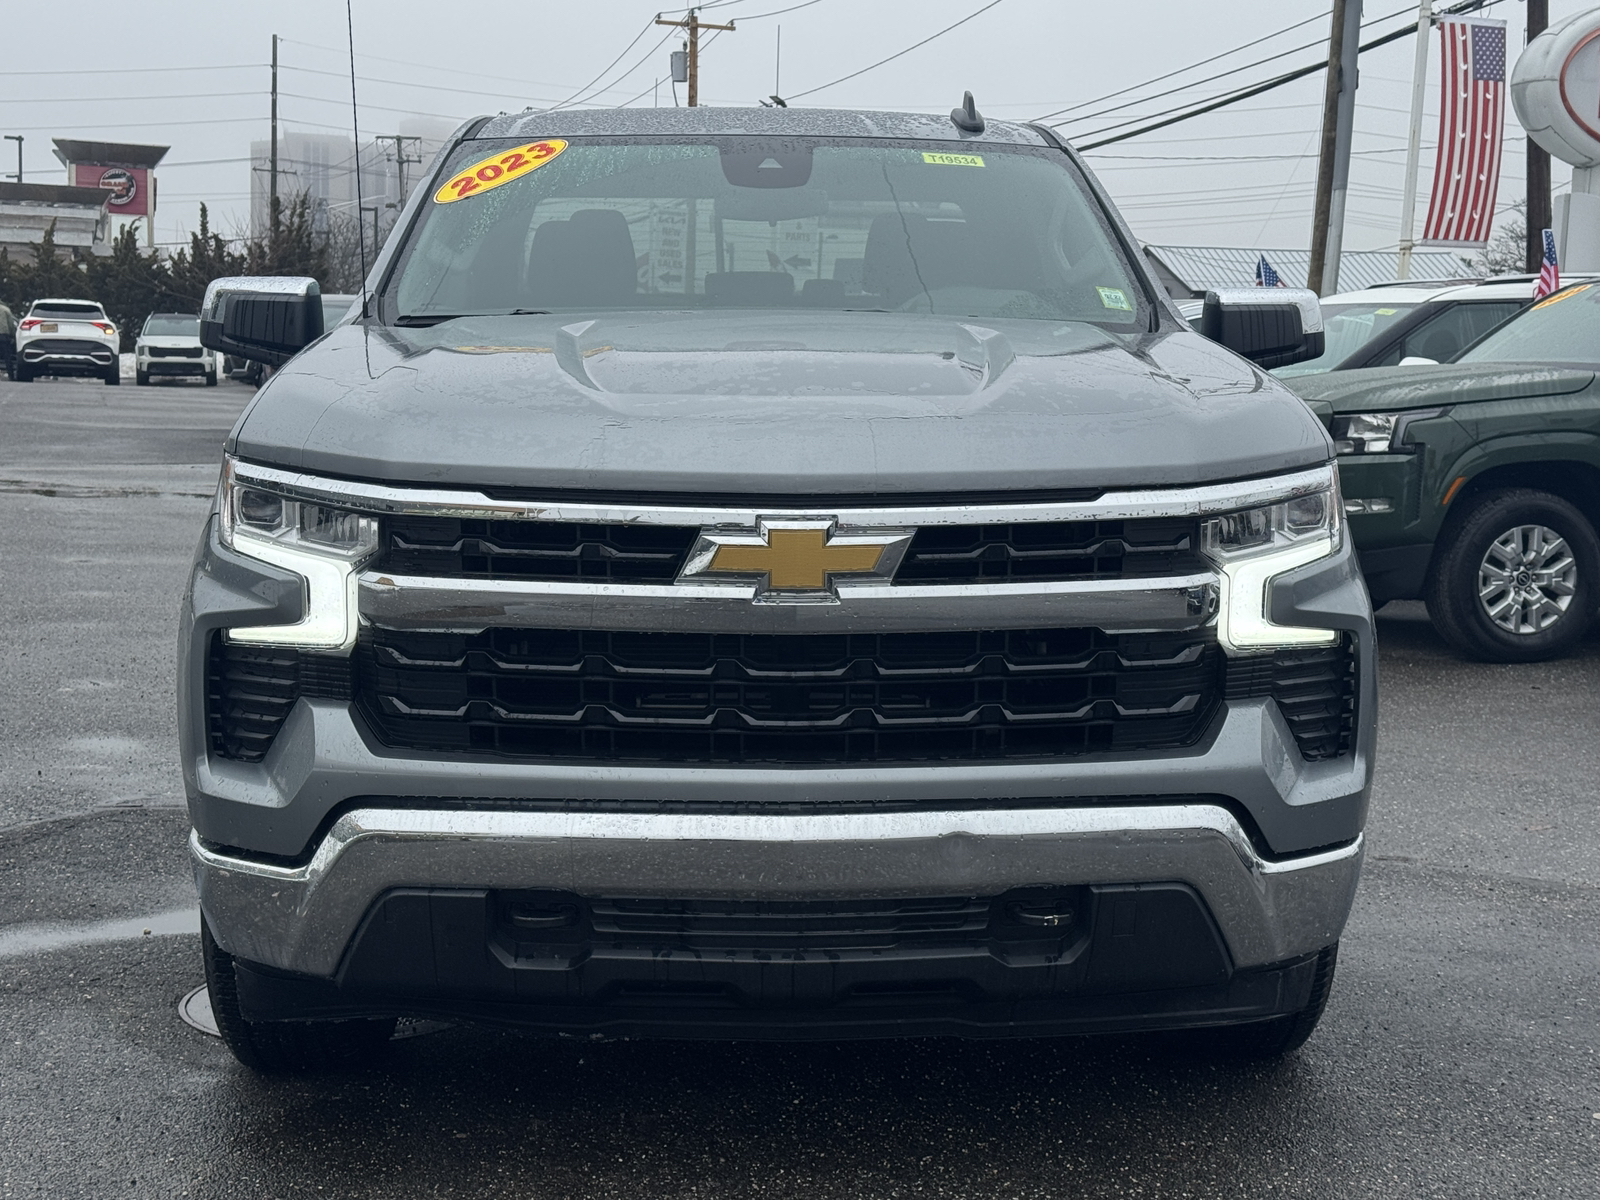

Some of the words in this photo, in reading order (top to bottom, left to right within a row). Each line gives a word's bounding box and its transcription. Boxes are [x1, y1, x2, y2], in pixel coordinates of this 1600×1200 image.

[928, 154, 978, 165] T19534
[450, 142, 557, 197] 2023
[662, 227, 681, 236] NEW
[785, 232, 811, 242] PARTS
[662, 238, 680, 247] AND
[659, 249, 682, 258] USED
[657, 258, 683, 269] SALES
